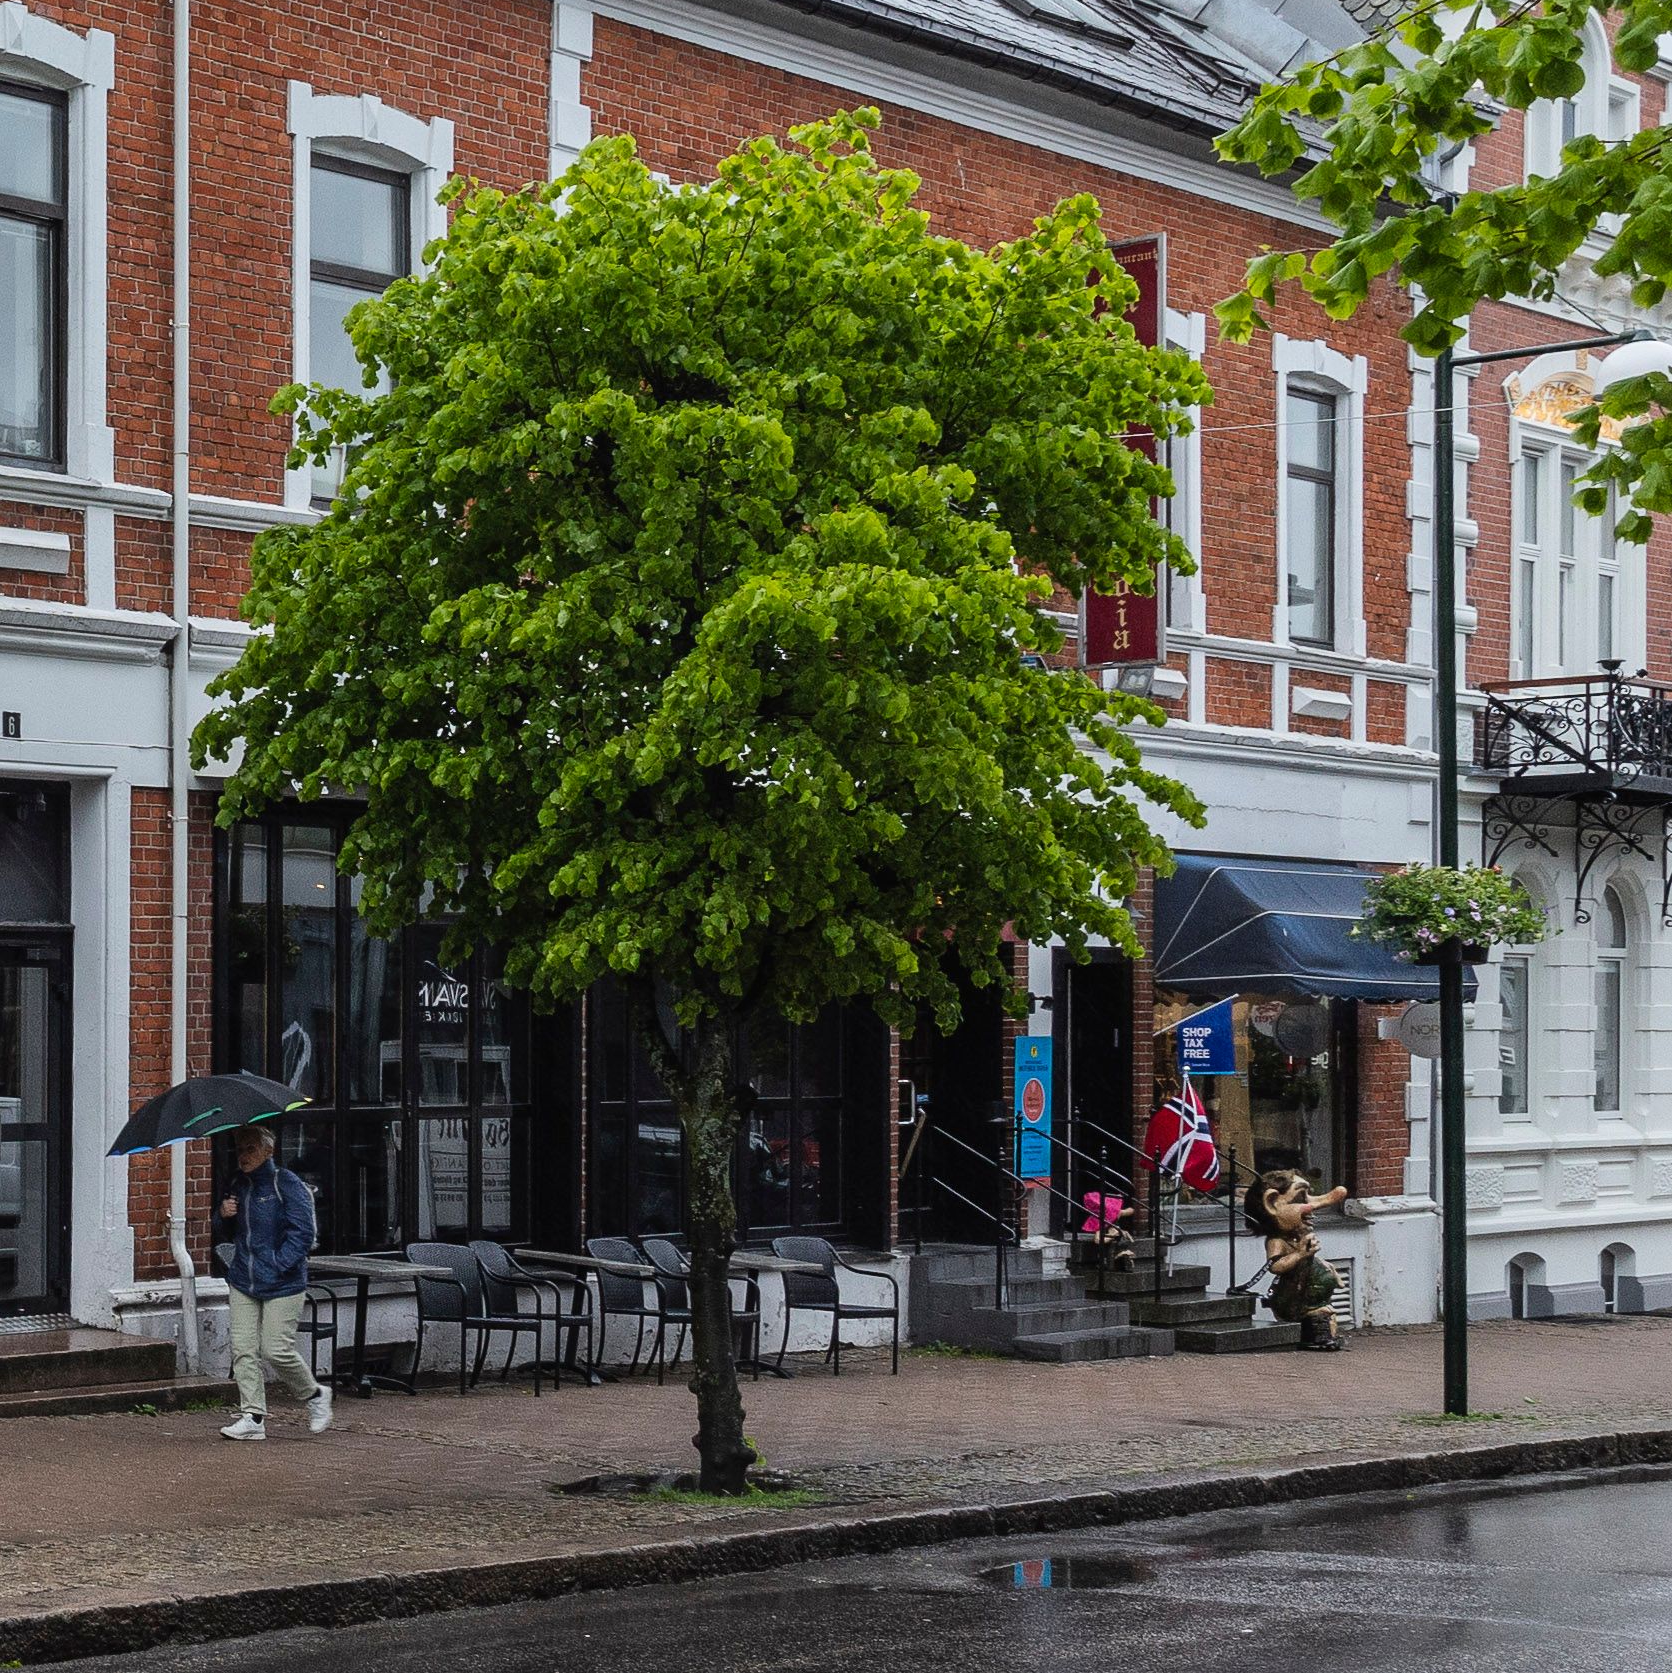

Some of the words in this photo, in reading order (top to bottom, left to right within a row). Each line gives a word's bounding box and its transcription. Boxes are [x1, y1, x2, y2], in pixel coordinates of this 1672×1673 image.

[8, 716, 15, 736] 6
[1182, 1027, 1212, 1037] SHOP
[1410, 1024, 1439, 1035] NOR
[1182, 1038, 1204, 1048] TAX
[1183, 1049, 1211, 1059] FREE
